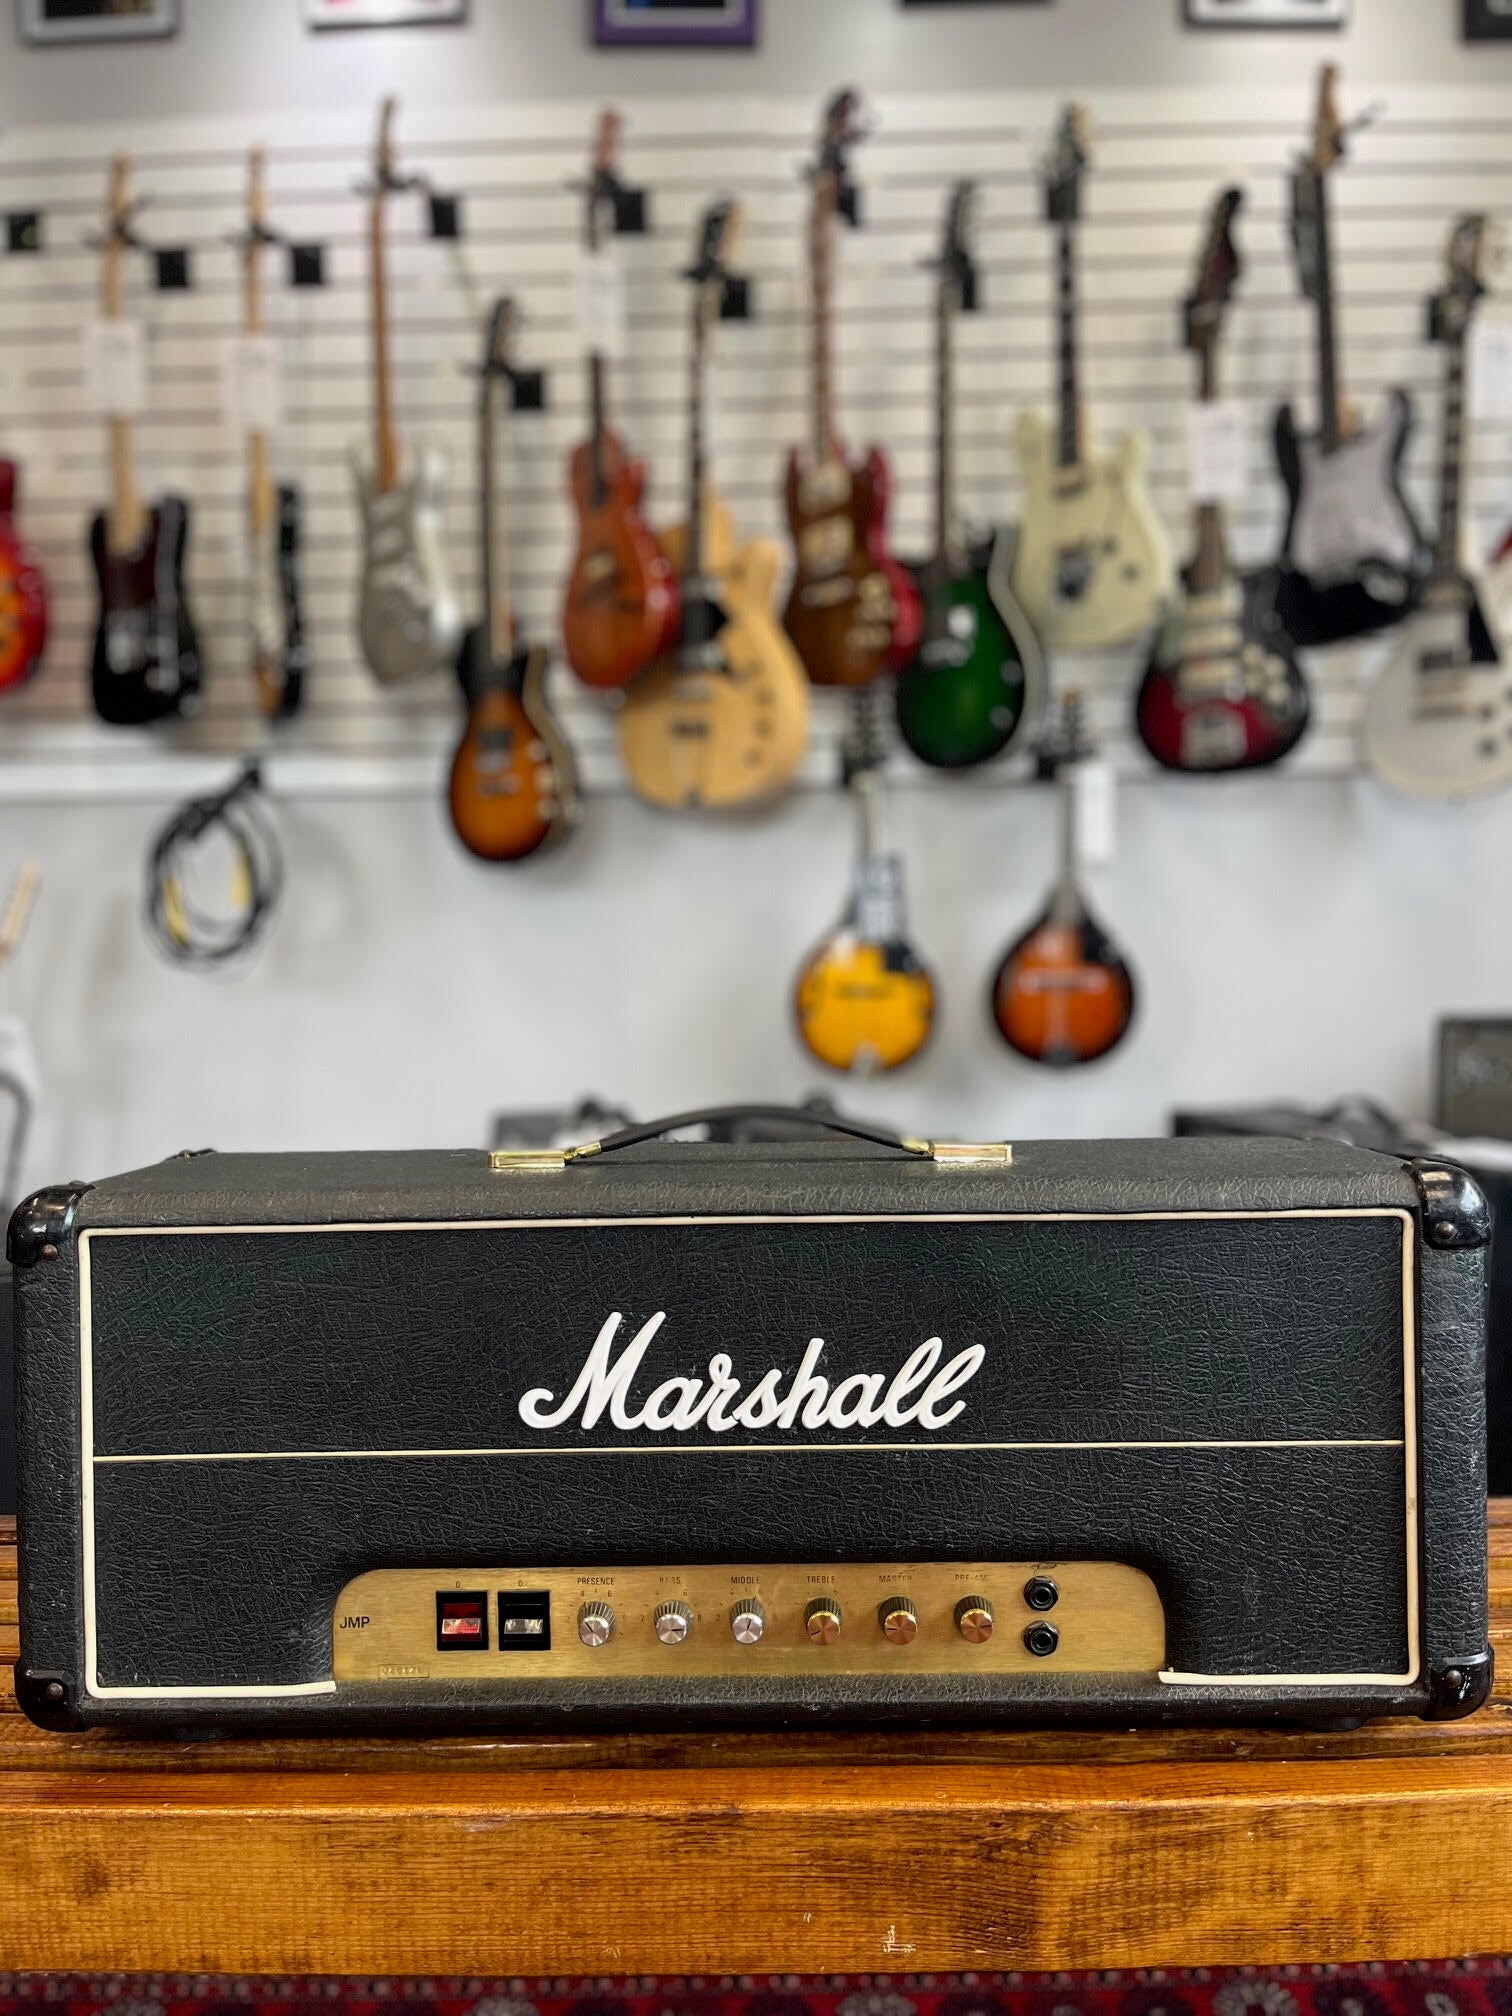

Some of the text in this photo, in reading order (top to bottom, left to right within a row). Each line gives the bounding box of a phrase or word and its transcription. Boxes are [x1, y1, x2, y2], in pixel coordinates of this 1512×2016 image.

[518, 1311, 986, 1431] Marshall
[577, 1577, 614, 1586] PRESENCE
[731, 1576, 760, 1585] MIDDLE
[807, 1575, 835, 1584] TREBLE
[879, 1574, 912, 1584] MASTER
[339, 1616, 370, 1629] JMP
